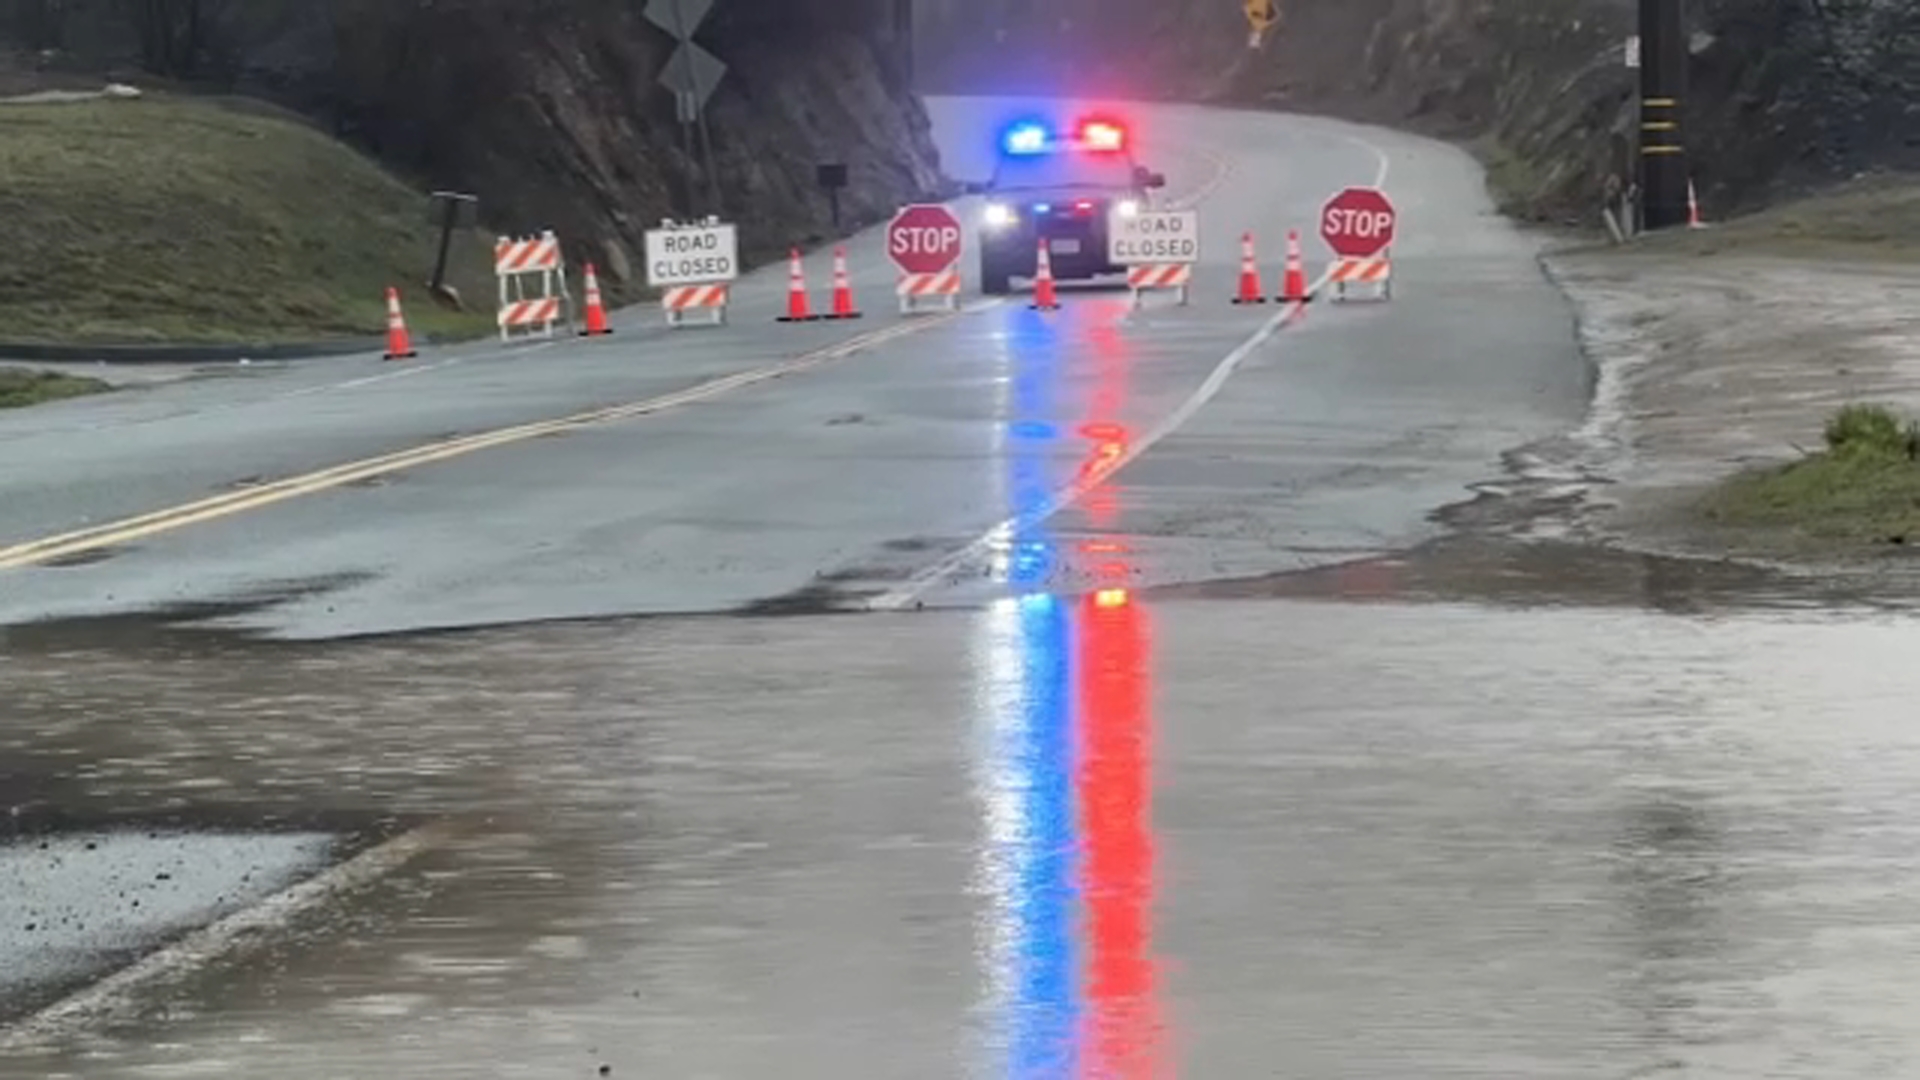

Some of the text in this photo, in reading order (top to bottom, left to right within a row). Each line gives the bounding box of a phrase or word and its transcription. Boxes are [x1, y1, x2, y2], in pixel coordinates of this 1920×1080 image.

[1325, 208, 1392, 237] STOP
[664, 233, 717, 252] ROAD
[893, 227, 958, 254] STOP
[1115, 240, 1195, 257] CLOSED
[654, 257, 730, 277] CLOSED
